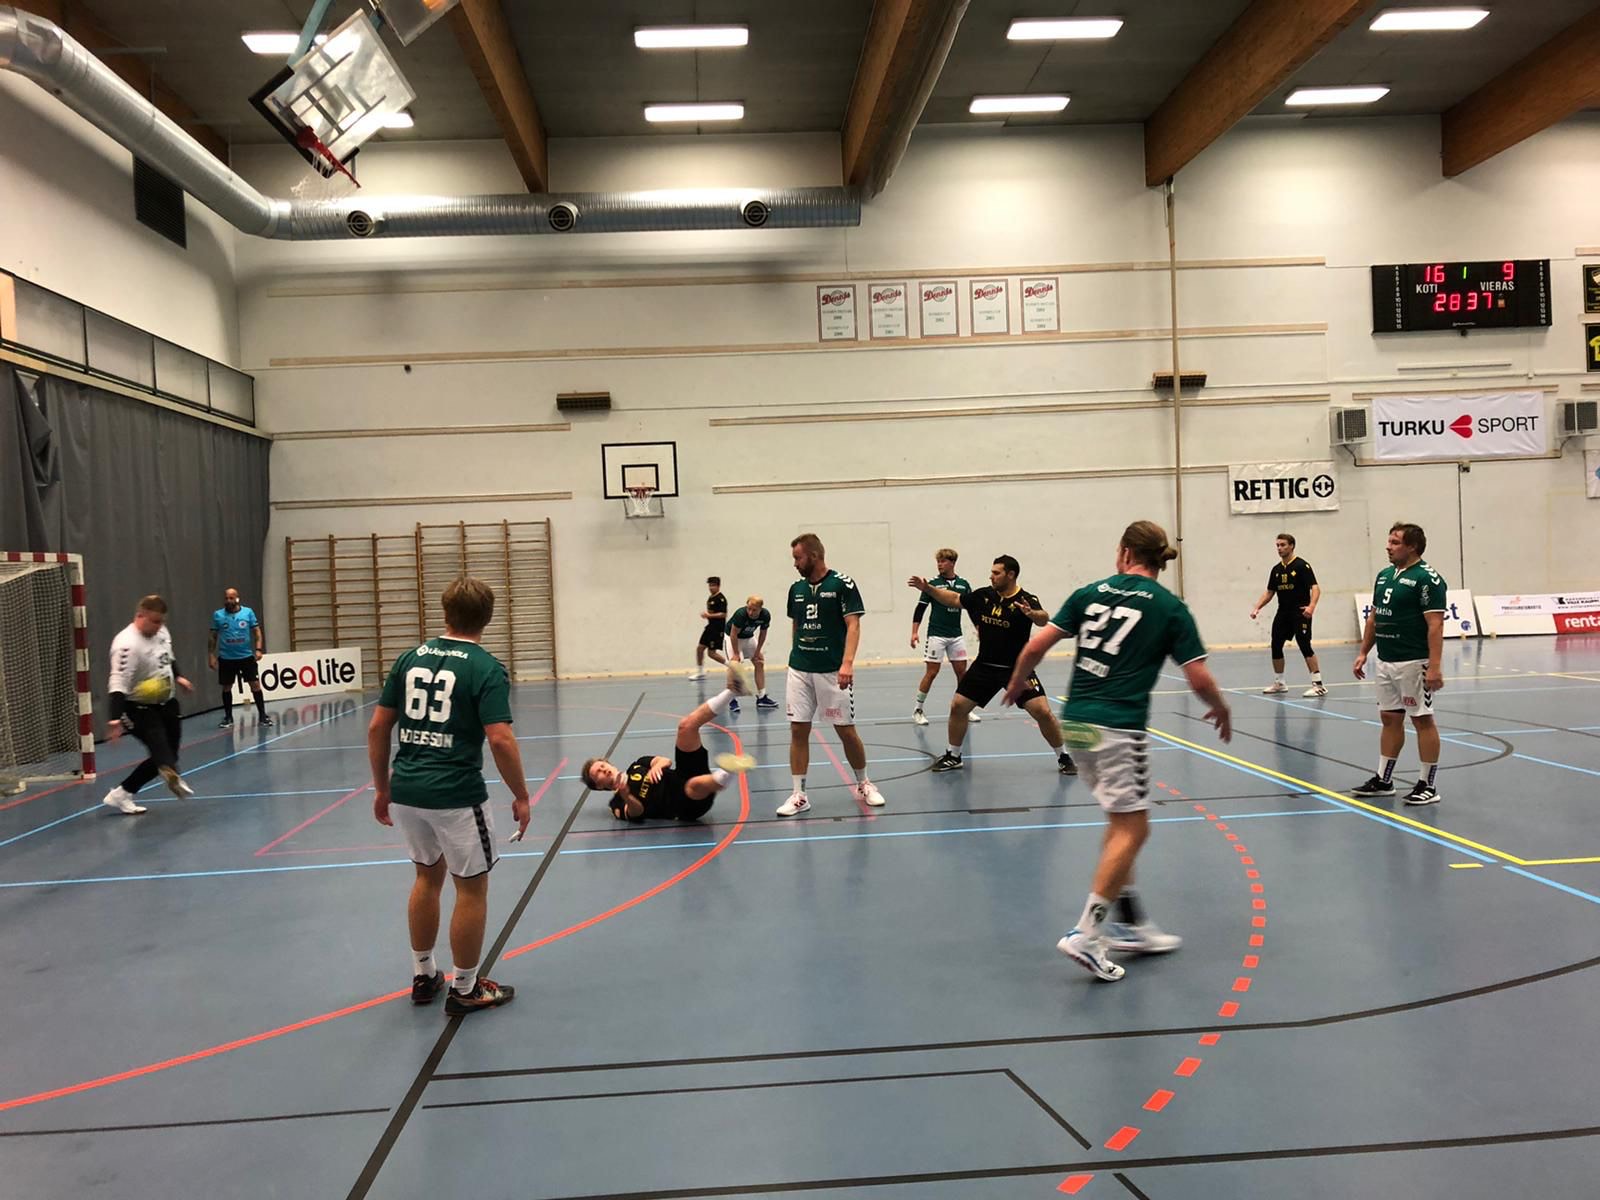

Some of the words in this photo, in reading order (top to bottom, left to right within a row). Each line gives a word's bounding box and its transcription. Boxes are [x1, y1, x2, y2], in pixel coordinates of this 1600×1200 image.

[1425, 265, 1445, 283] 16
[1502, 262, 1514, 281] 9
[1416, 284, 1438, 294] KOTI
[1480, 281, 1515, 291] VIERAS
[1378, 419, 1445, 438] TURKU
[1477, 415, 1540, 434] SPORT
[1233, 477, 1310, 502] RETTIG
[1382, 587, 1394, 605] 5
[805, 604, 818, 620] 21
[991, 603, 1003, 617] 14
[1079, 603, 1143, 656] 27
[405, 666, 457, 723] 63
